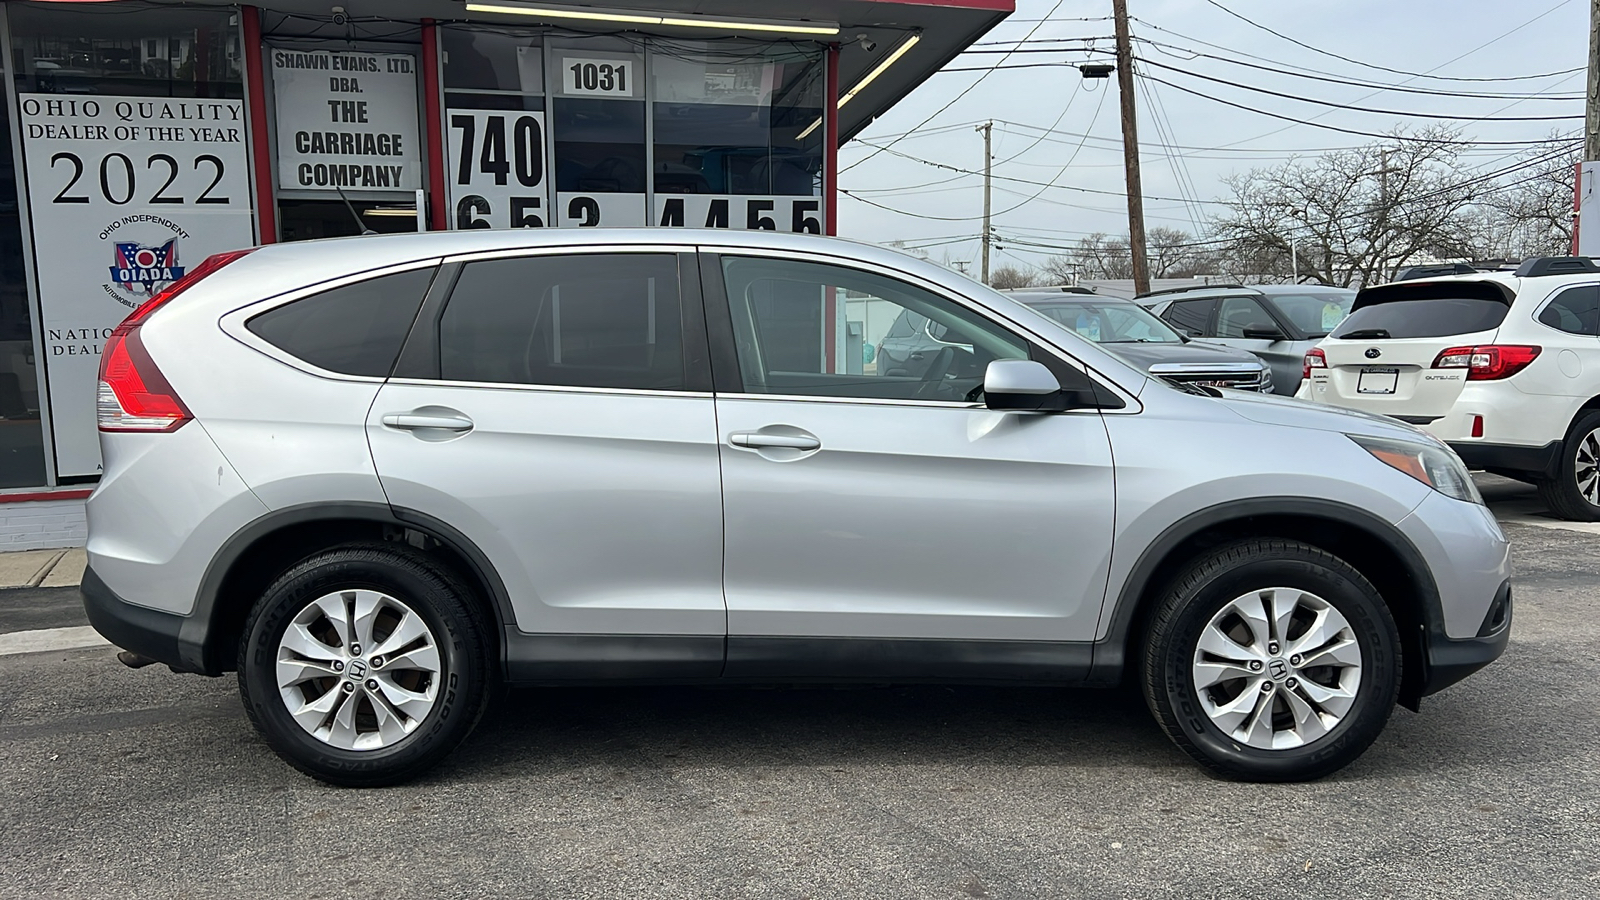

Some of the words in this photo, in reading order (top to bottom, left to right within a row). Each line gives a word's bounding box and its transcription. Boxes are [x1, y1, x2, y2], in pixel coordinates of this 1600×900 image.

[275, 52, 329, 70] SHAWN
[332, 55, 381, 72] EVANS.
[386, 58, 414, 74] LTD.
[329, 77, 364, 93] DBA.
[570, 62, 626, 92] 1031
[22, 98, 101, 118] OHIO
[115, 101, 242, 122] QUALITY
[327, 100, 369, 123] THE
[27, 123, 110, 140] DEALER
[114, 126, 140, 141] OF
[144, 126, 185, 141] THE
[189, 127, 241, 143] YEAR
[295, 130, 403, 156] CARRIAGE
[451, 114, 543, 188] 740
[50, 151, 231, 205] 2022
[298, 163, 403, 188] COMPANY
[98, 220, 121, 241] OHIO
[121, 214, 190, 241] INDEPENDENT
[119, 267, 173, 282] OIADA
[102, 283, 136, 309] AUTOMOBILE
[48, 327, 114, 341] NATIO
[52, 344, 102, 356] DEAL
